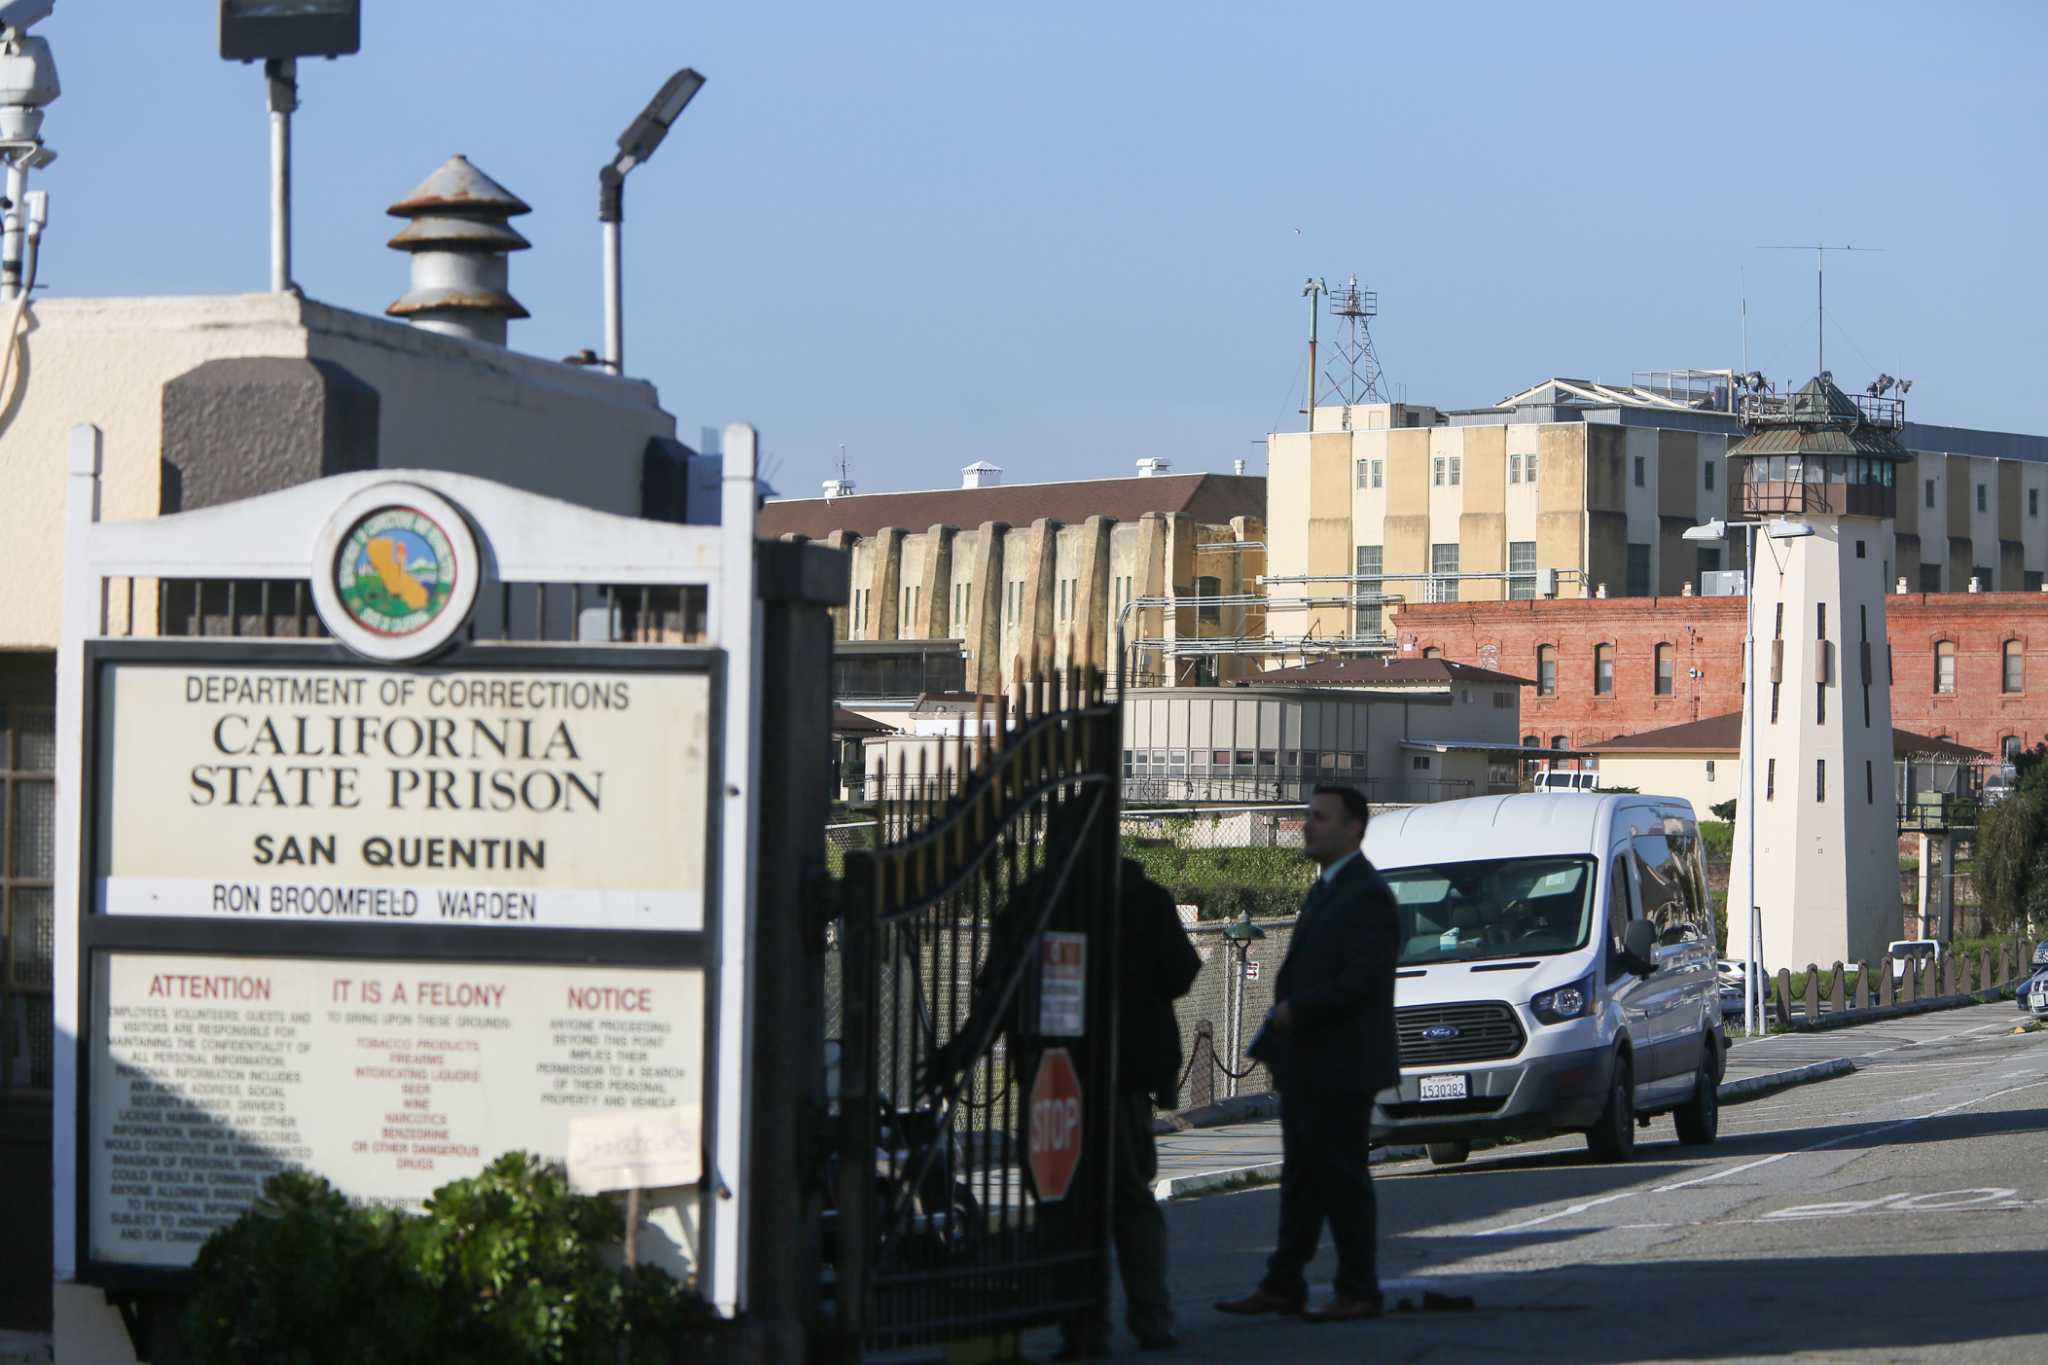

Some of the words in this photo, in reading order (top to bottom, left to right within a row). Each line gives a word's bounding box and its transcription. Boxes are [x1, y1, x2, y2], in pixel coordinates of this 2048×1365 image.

[186, 676, 367, 705] DEPARTMENT
[380, 679, 415, 706] OF
[428, 679, 630, 709] CORRECTIONS
[213, 714, 581, 760] CALIFORNIA
[190, 765, 361, 808] STATE
[387, 767, 604, 813] PRISON
[254, 834, 337, 865] SAN
[362, 836, 545, 869] QUENTIN
[213, 885, 260, 912] RON
[270, 886, 418, 917] BROOMFIELD
[438, 890, 537, 920] WARDEN
[149, 974, 271, 1000] ATTENTION
[333, 979, 351, 1003] IT
[362, 980, 382, 1004] IS
[392, 980, 407, 1005] A
[417, 982, 506, 1007] FELONY
[567, 986, 653, 1012] NOTICE
[1031, 1097, 1079, 1152] STOP
